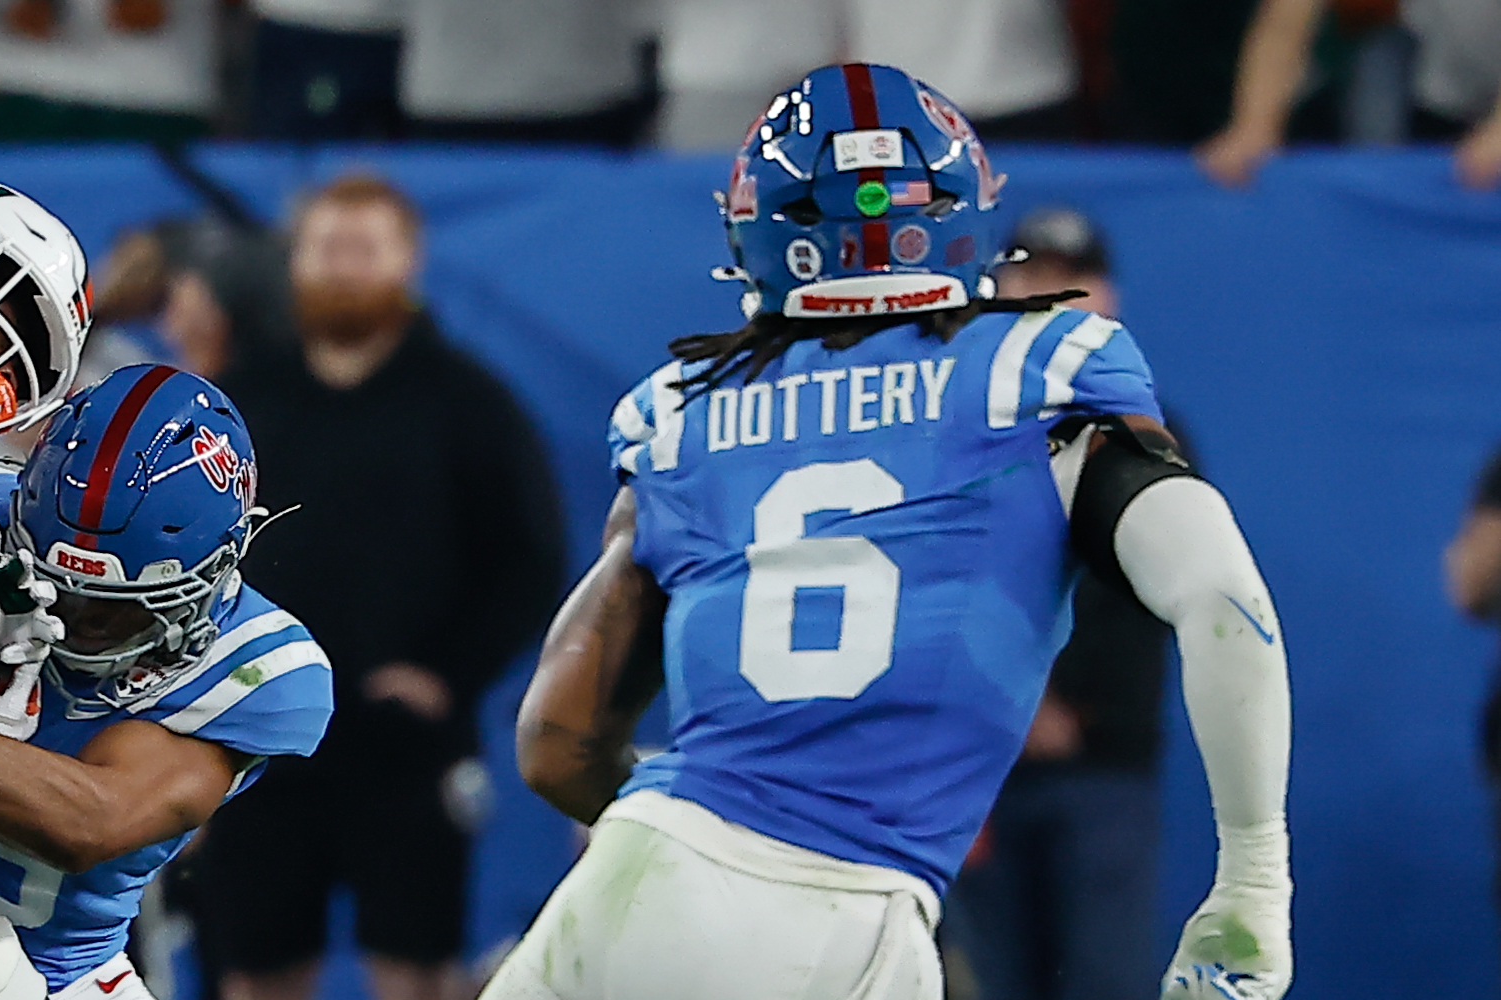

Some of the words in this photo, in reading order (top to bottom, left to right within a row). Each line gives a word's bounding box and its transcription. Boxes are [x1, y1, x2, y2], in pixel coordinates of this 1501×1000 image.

[708, 356, 957, 453] DOTTERY
[57, 550, 106, 577] REBS
[739, 457, 904, 704] 6
